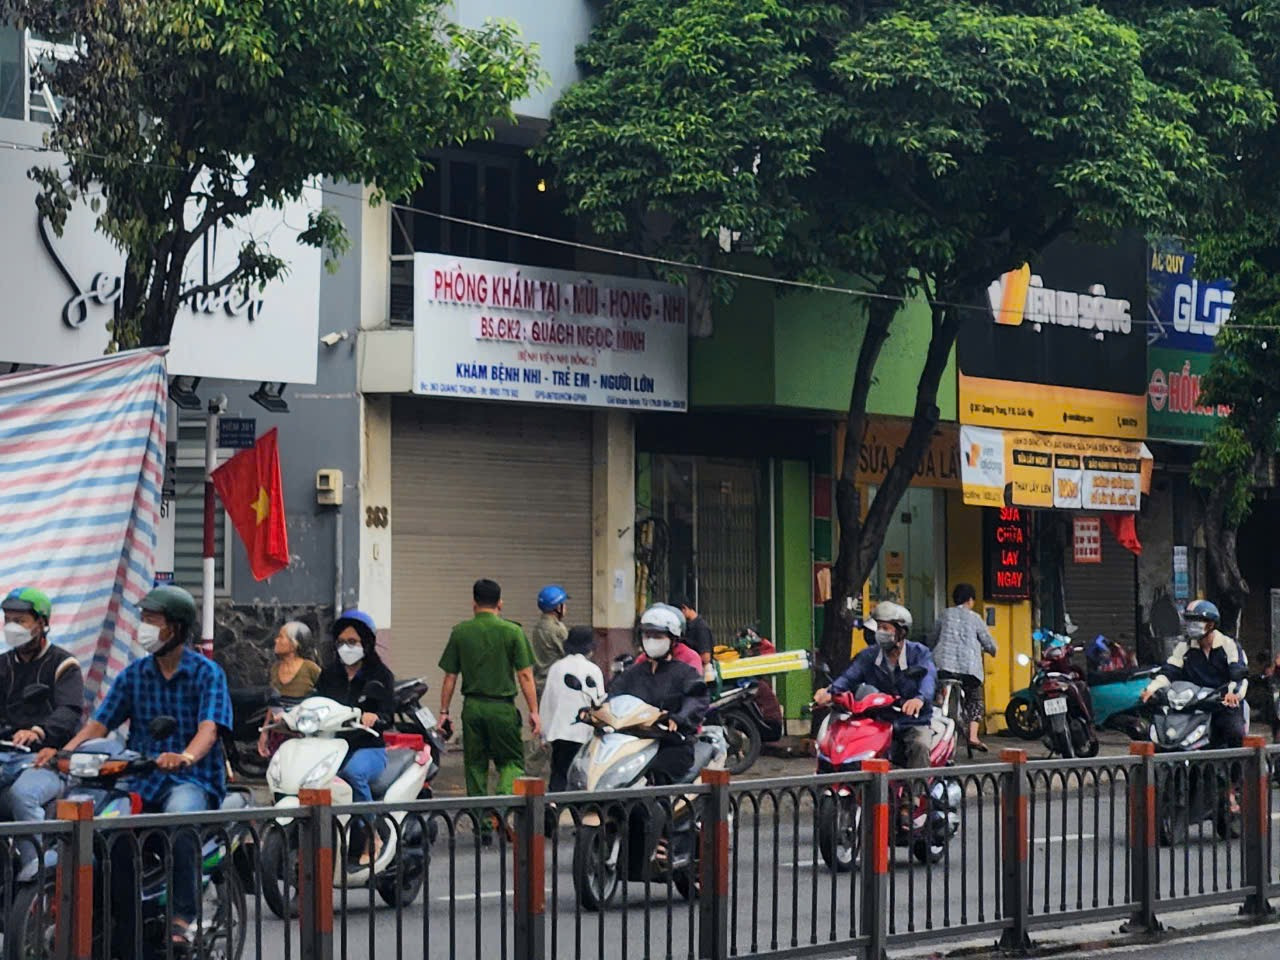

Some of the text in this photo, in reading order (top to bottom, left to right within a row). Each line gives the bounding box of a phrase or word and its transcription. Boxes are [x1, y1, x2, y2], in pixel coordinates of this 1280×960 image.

[434, 263, 488, 304] PHÒNG
[492, 270, 535, 310] KHÁM
[540, 280, 560, 313] TAI
[609, 288, 651, 327] HỌNG
[663, 294, 687, 324] NHI
[531, 316, 574, 345] QUÁCH
[576, 326, 613, 354] NGỌC
[616, 329, 645, 352] MINH
[455, 360, 488, 380] KHÁM
[491, 362, 520, 384] BỆNH
[523, 368, 541, 384] NHI
[552, 366, 571, 387] TRẺ
[574, 373, 590, 388] EM
[634, 373, 654, 393] LỚN
[996, 571, 1023, 588] NGAY
